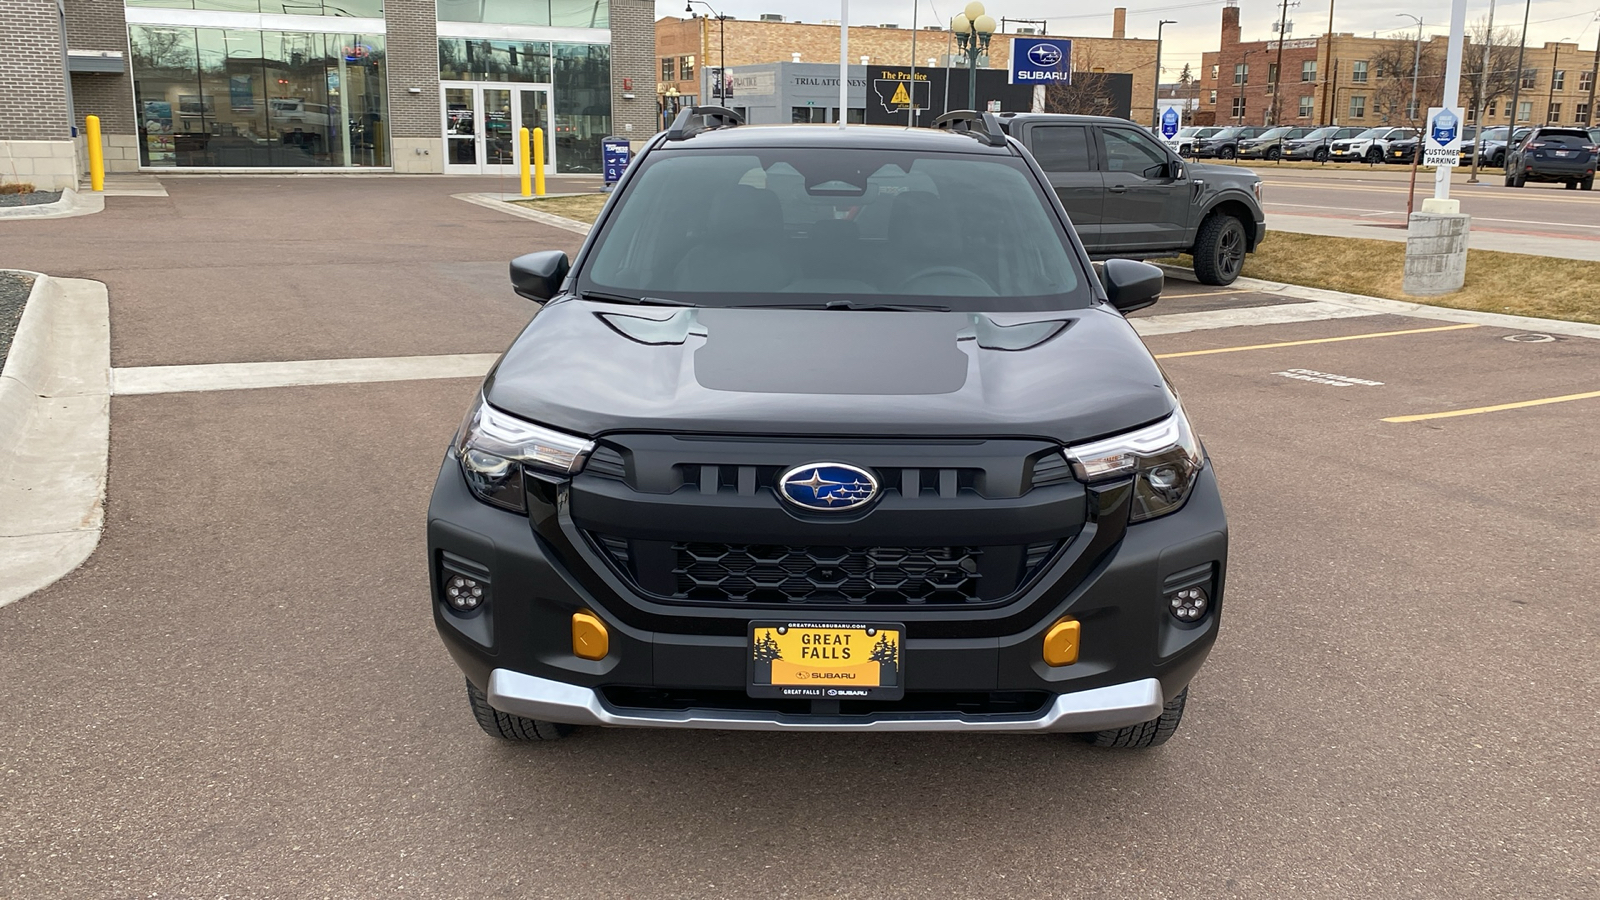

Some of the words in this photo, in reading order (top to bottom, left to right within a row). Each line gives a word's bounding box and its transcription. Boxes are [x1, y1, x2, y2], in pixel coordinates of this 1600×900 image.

[882, 71, 896, 79] The
[898, 71, 928, 80] Pratice
[1018, 71, 1067, 80] SUBARU
[795, 77, 819, 86] TRIAL
[821, 78, 867, 87] ATTONEYS
[1427, 157, 1456, 165] PARKING
[801, 633, 851, 645] GREAT
[801, 646, 851, 659] FALLS
